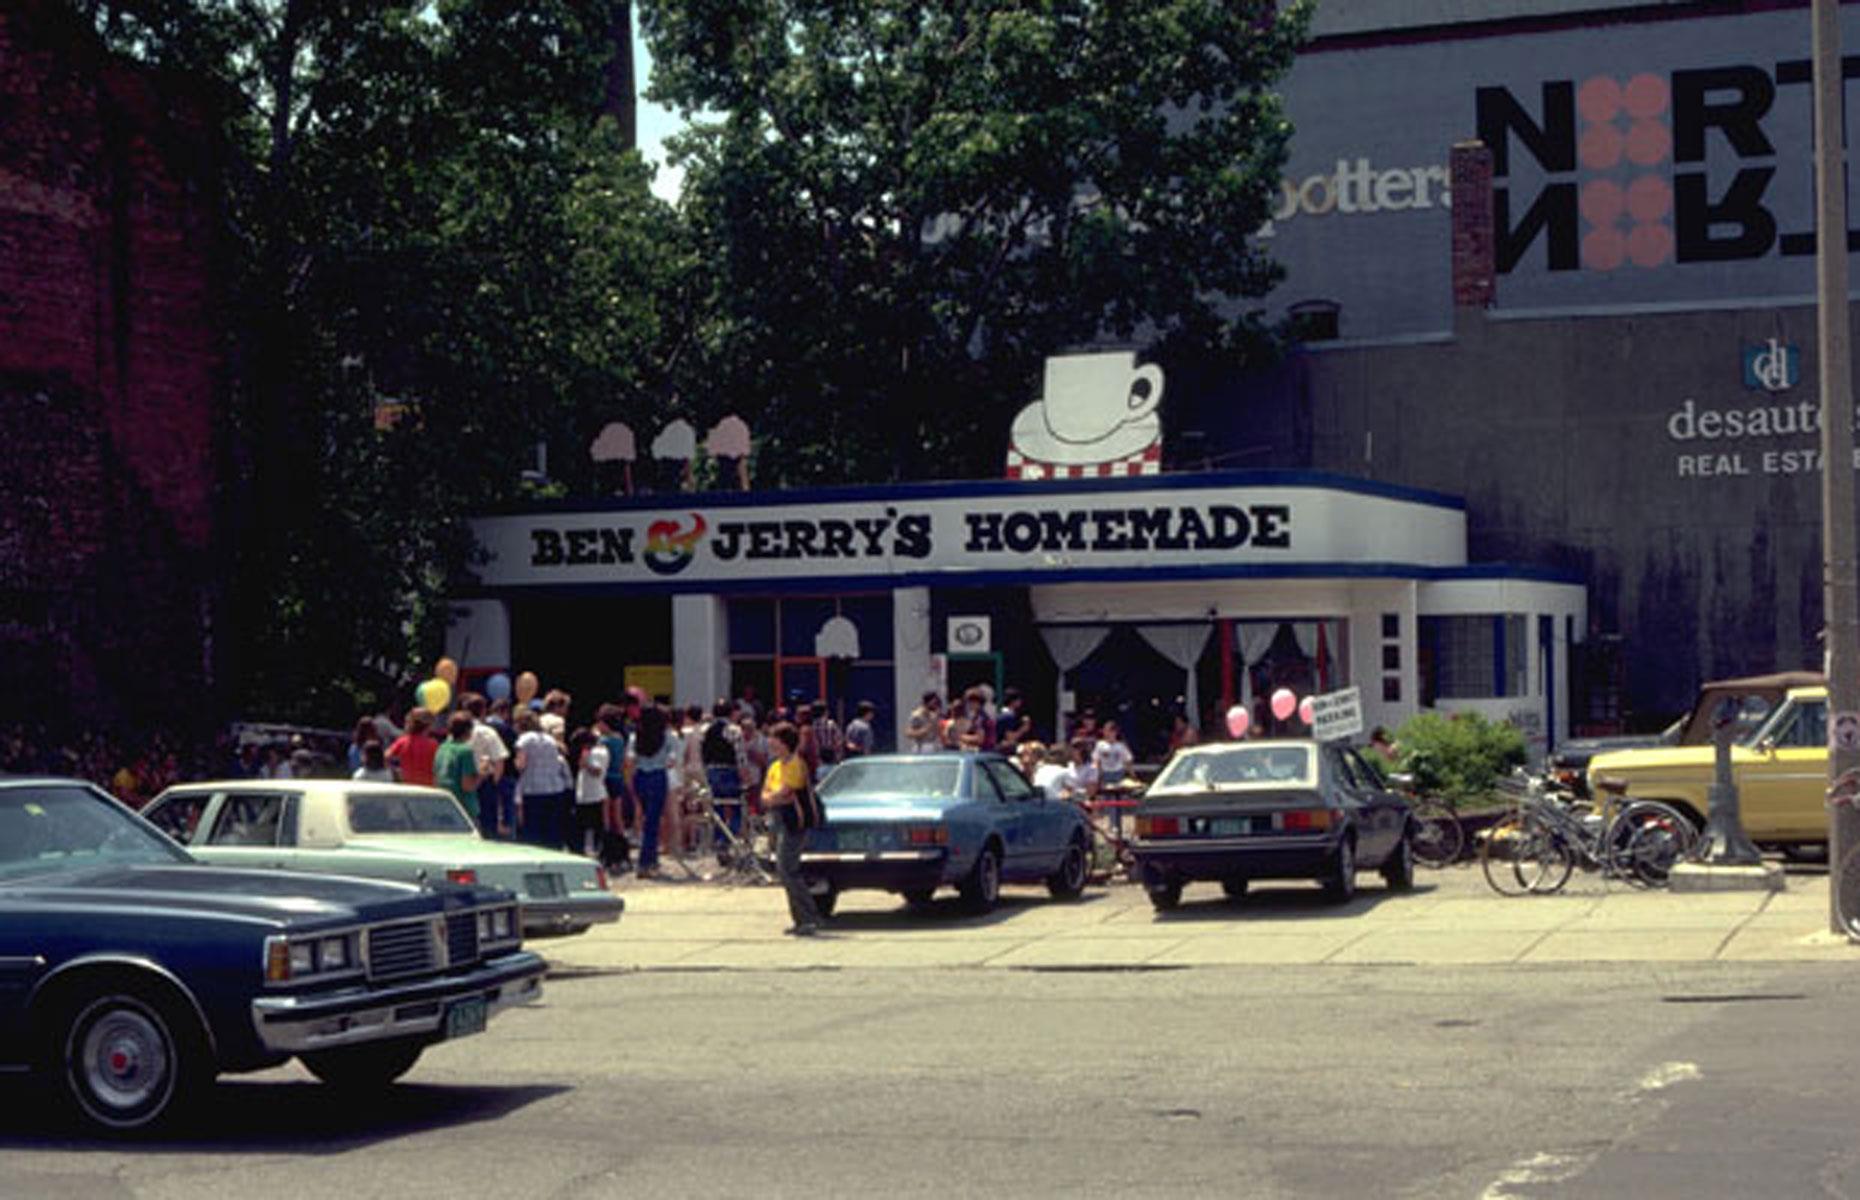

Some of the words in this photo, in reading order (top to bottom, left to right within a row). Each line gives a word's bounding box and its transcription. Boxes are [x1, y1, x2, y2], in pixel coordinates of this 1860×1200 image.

[1667, 399, 1860, 440] desaut
[1678, 454, 1749, 477] REAL
[1762, 449, 1860, 473] EST
[531, 528, 634, 566] BEN
[643, 512, 707, 576] &
[711, 507, 931, 561] JERRY'S
[965, 505, 1290, 553] HOMEMADE
